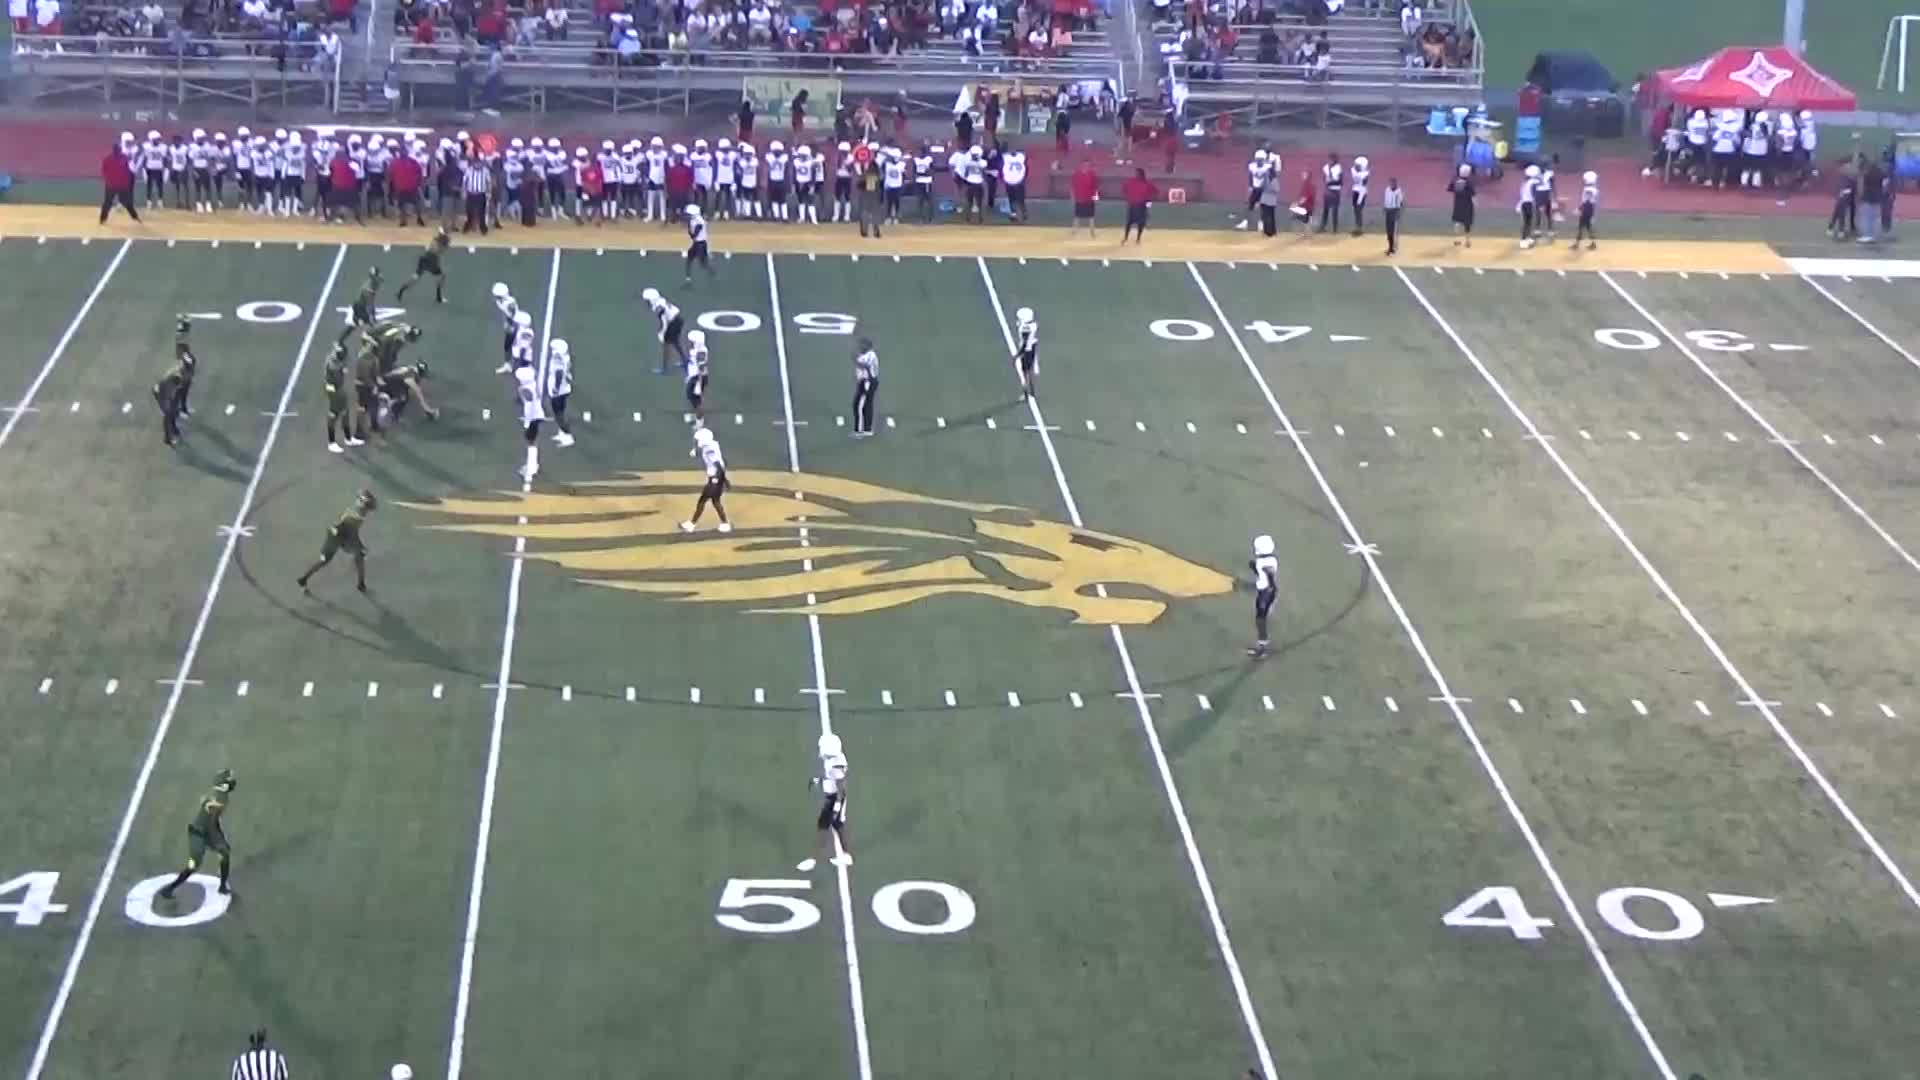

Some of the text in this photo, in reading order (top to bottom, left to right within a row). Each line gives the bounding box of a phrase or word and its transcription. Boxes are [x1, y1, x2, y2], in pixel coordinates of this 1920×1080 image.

[697, 310, 857, 334] 50
[1150, 319, 1312, 343] 40
[1594, 328, 1754, 352] 30
[714, 878, 976, 934] 50
[1442, 887, 1705, 940] 40
